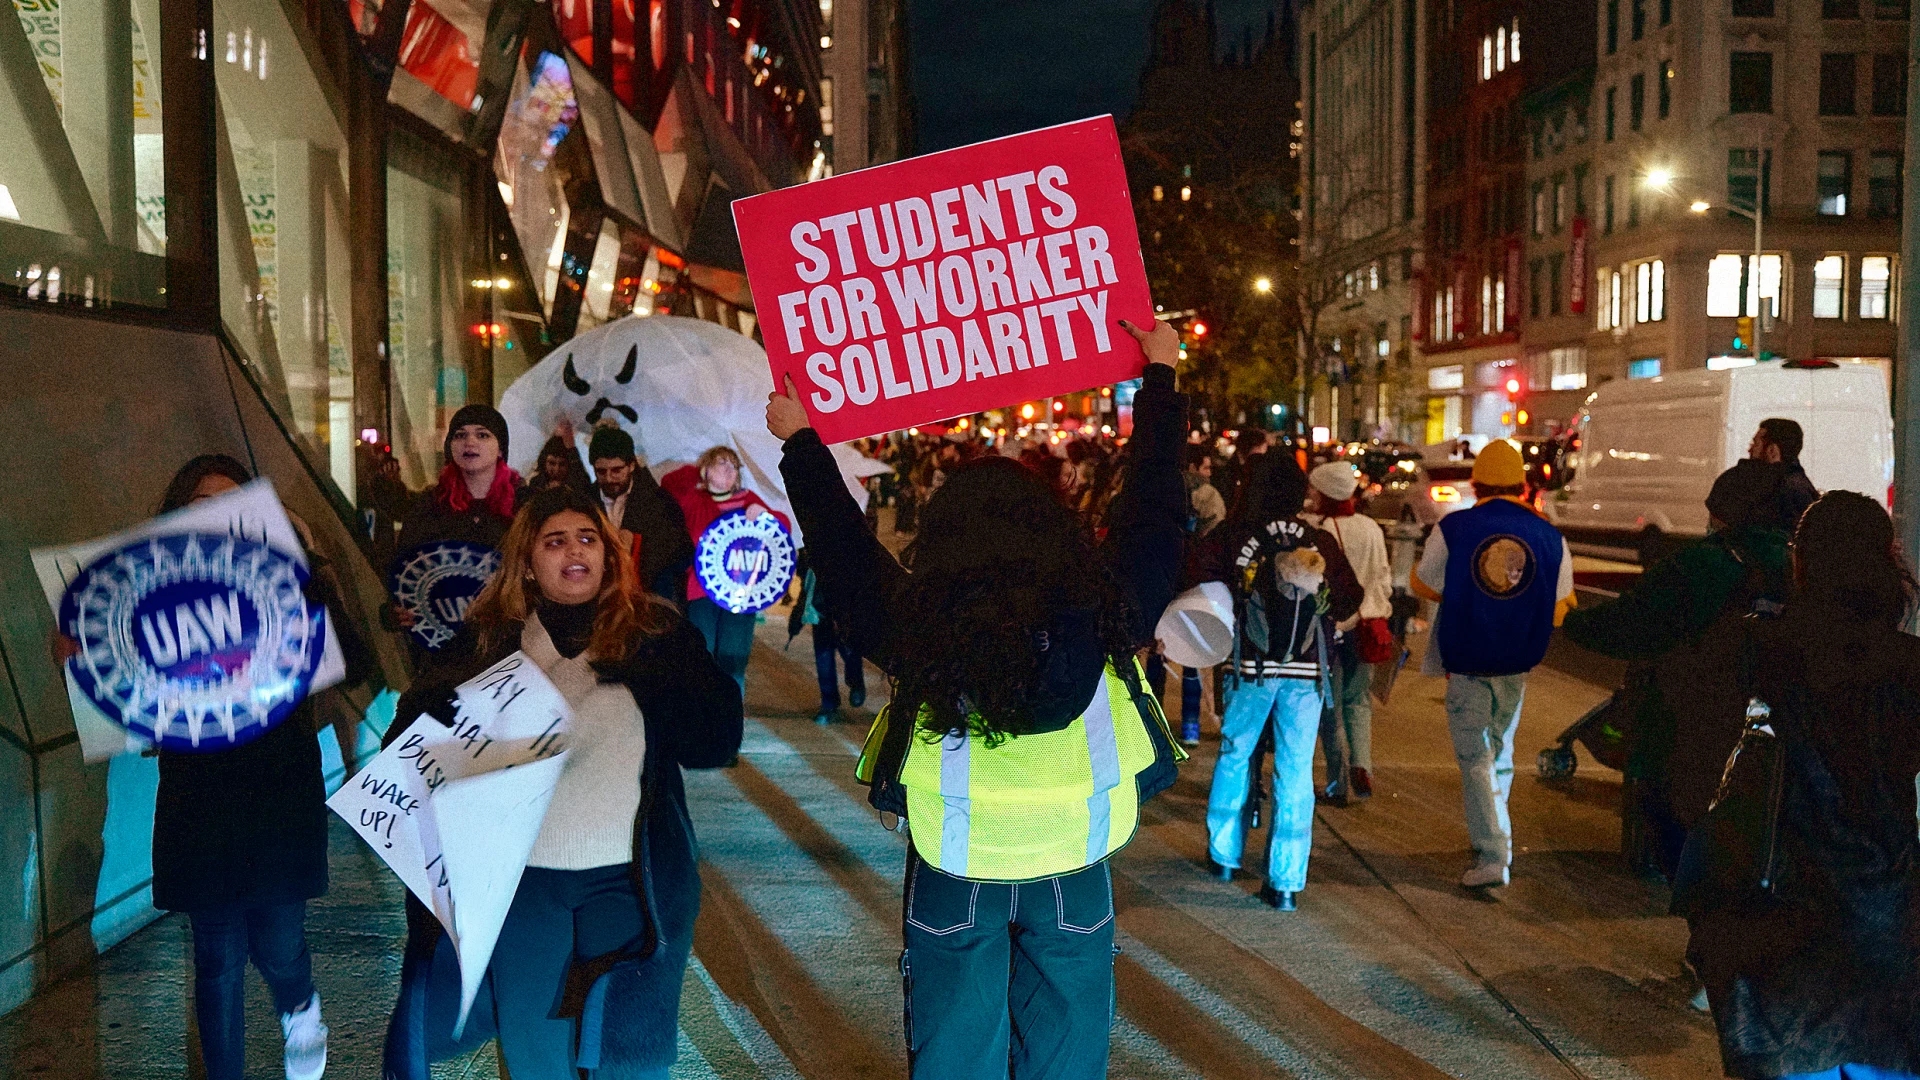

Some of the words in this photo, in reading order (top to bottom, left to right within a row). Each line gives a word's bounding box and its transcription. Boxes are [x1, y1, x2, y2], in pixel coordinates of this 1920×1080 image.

[790, 165, 1077, 284] STUDENTS
[777, 277, 886, 354] FOR
[881, 225, 1119, 329] WORKER
[805, 290, 1112, 413] SOLIDARITY
[726, 548, 769, 572] UAW
[141, 590, 243, 668] UAW
[434, 595, 474, 622] UA
[475, 658, 527, 713] PAY
[361, 773, 420, 816] WAKE
[360, 808, 397, 849] UP!
